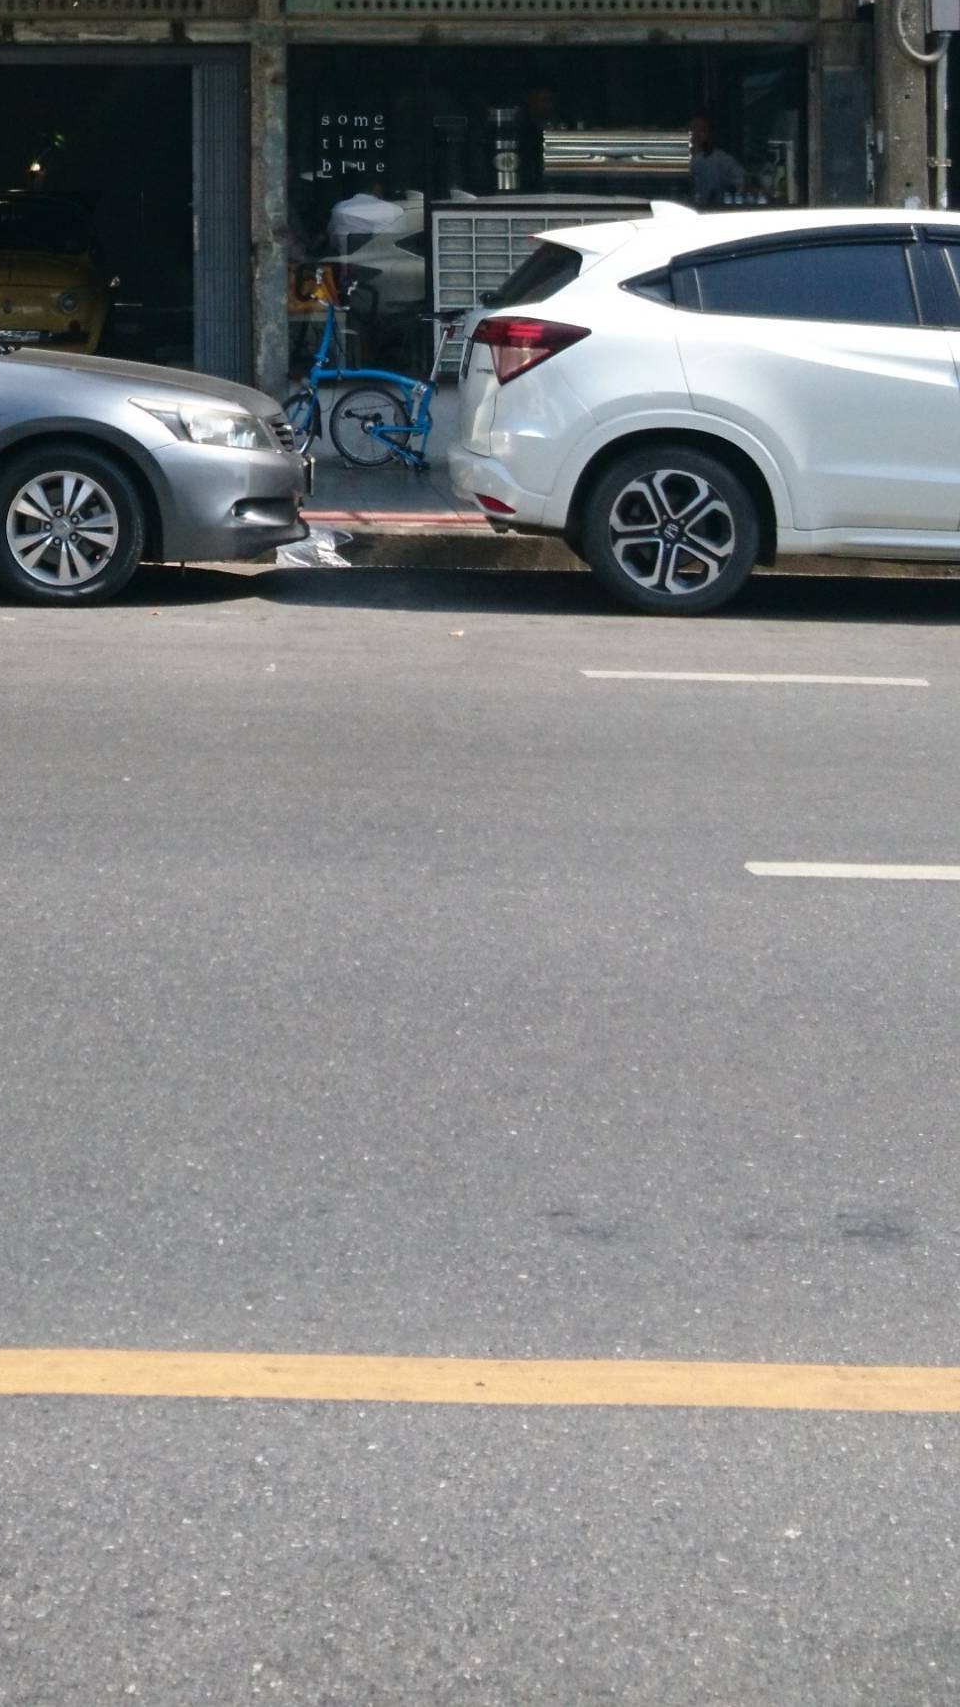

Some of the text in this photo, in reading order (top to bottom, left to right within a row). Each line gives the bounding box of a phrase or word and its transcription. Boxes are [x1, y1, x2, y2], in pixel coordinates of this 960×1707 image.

[321, 114, 385, 130] some
[322, 135, 385, 150] time
[322, 159, 385, 177] blue
